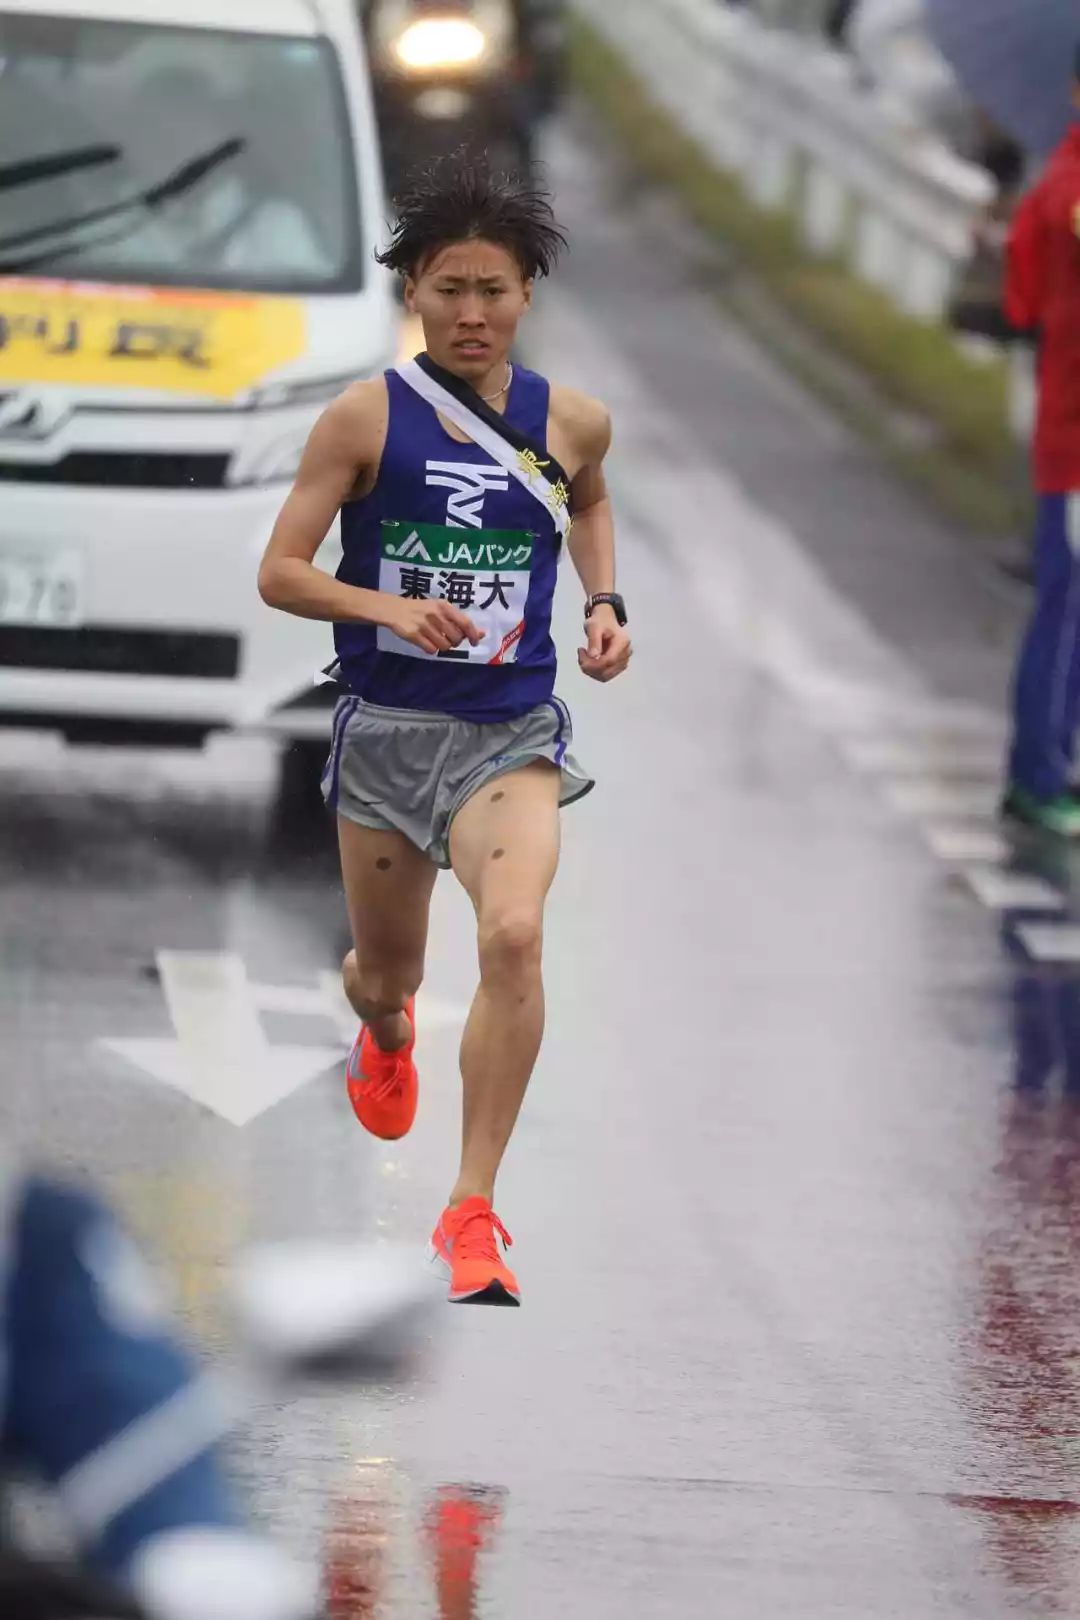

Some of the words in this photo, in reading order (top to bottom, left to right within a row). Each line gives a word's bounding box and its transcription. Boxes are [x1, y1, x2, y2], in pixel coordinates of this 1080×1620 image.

[438, 542, 532, 566] JAバンク
[399, 567, 515, 610] 東海大
